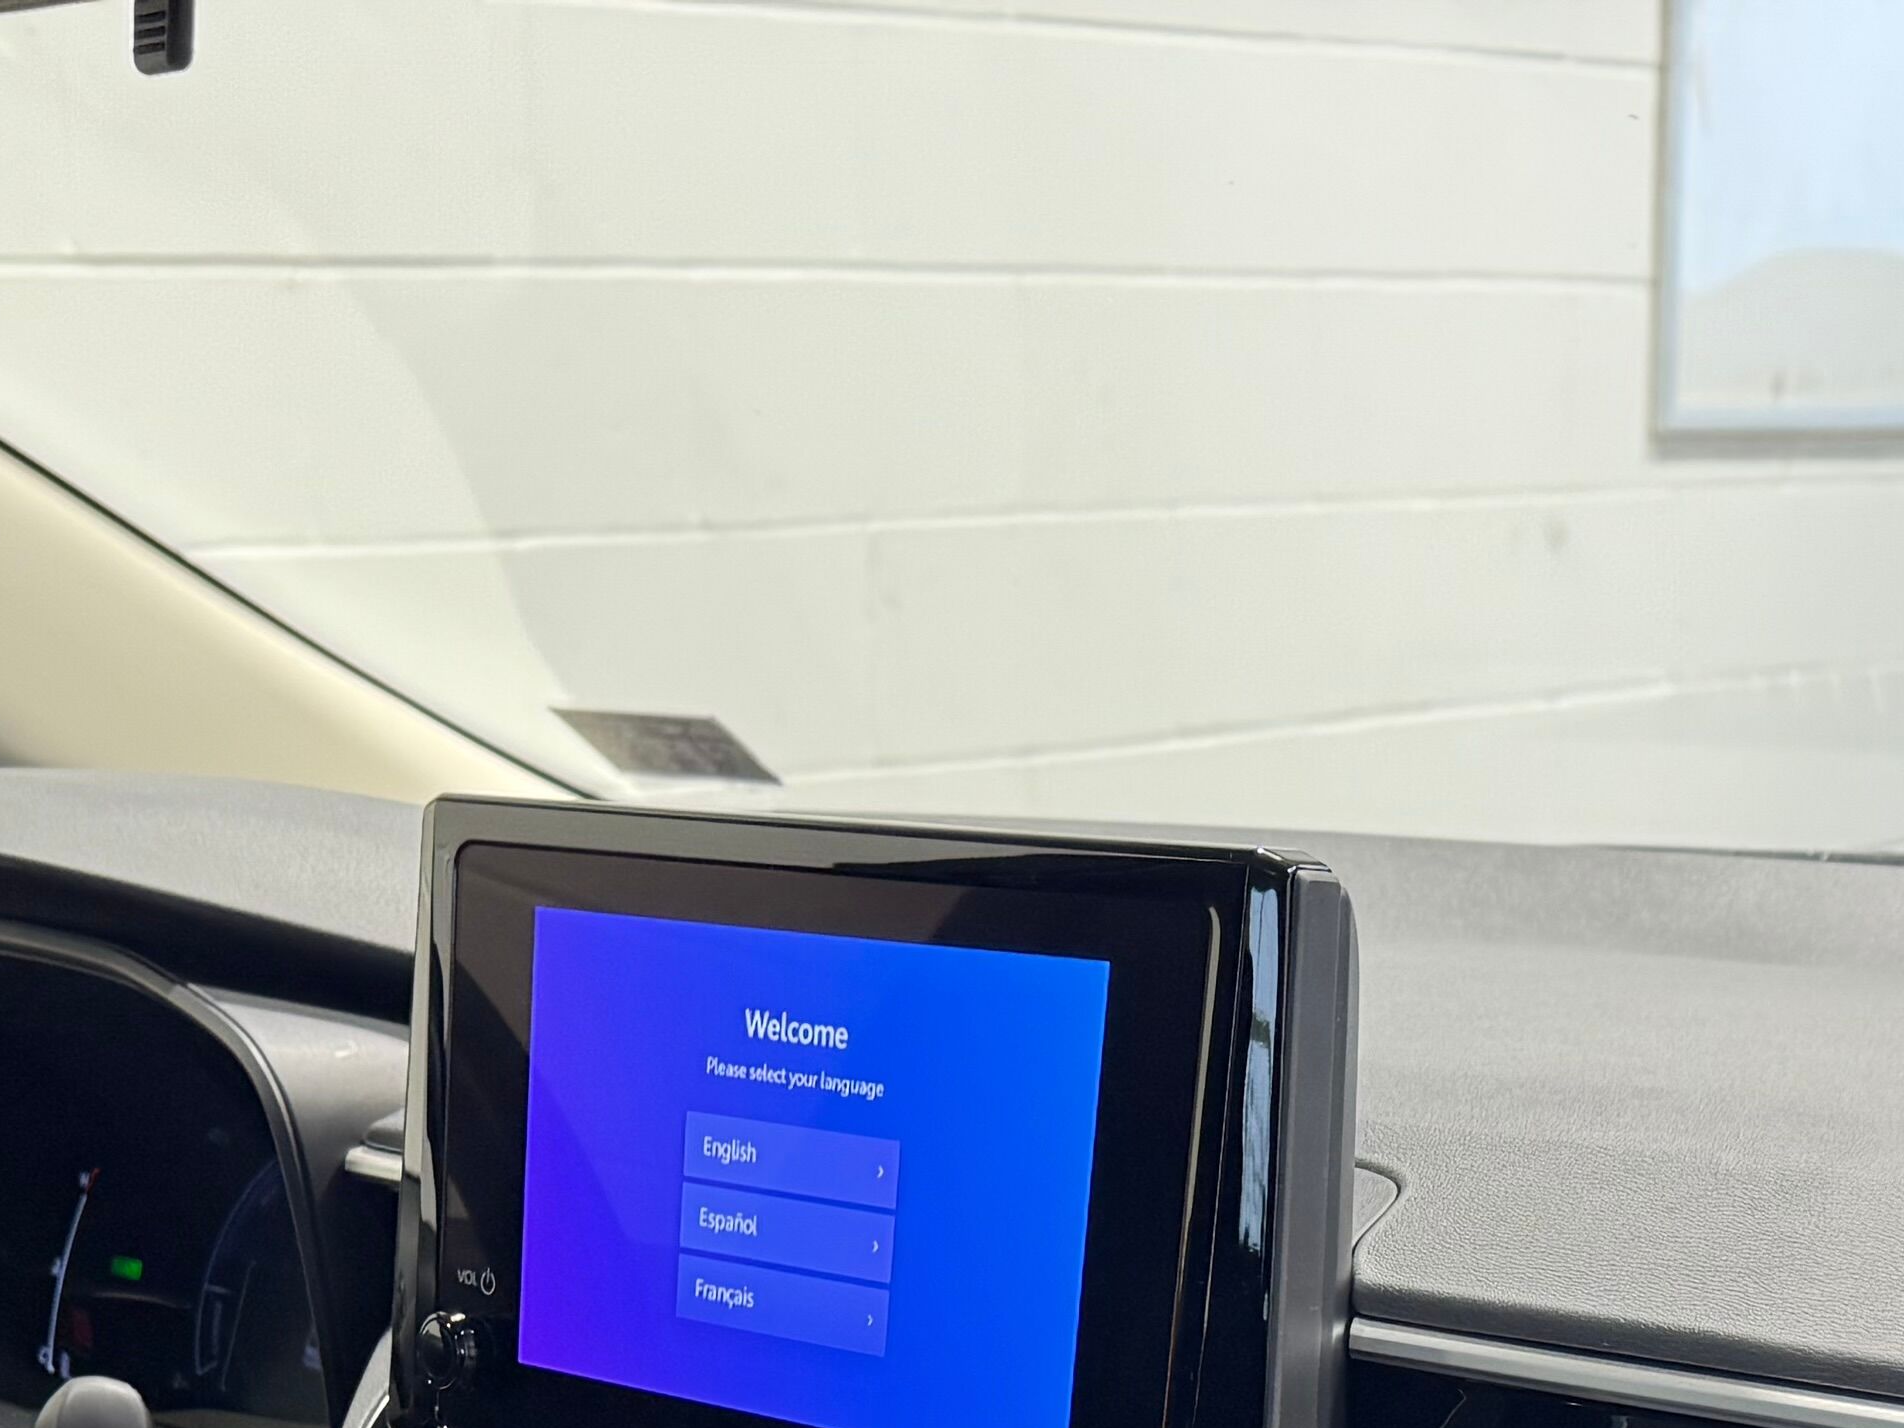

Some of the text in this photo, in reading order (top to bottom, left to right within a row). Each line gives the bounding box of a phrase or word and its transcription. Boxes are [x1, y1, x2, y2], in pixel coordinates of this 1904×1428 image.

[745, 1008, 848, 1050] Welcome
[706, 1056, 885, 1101] Please select your language
[703, 1135, 757, 1165] English
[699, 1206, 758, 1237] Español
[457, 1269, 477, 1287] VOL
[694, 1277, 755, 1309] Français
